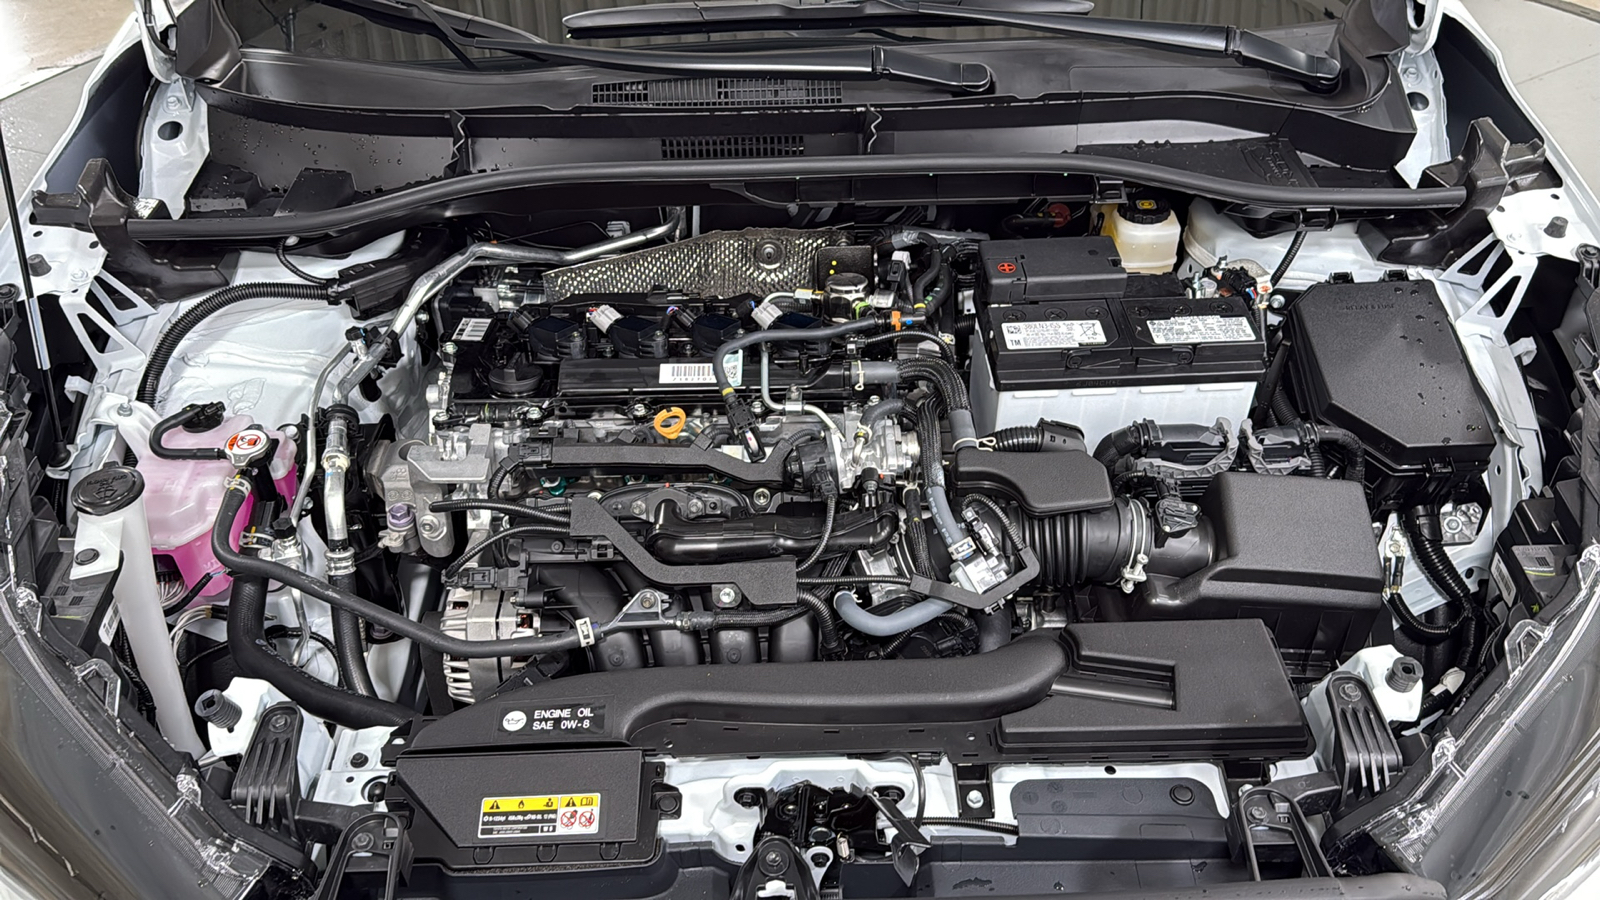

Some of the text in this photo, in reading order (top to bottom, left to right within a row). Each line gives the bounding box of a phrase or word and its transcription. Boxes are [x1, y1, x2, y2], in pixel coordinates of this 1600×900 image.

[1010, 339, 1022, 347] TM
[533, 707, 595, 719] ENGINE OIL
[532, 719, 590, 730] SAE 0W-8
